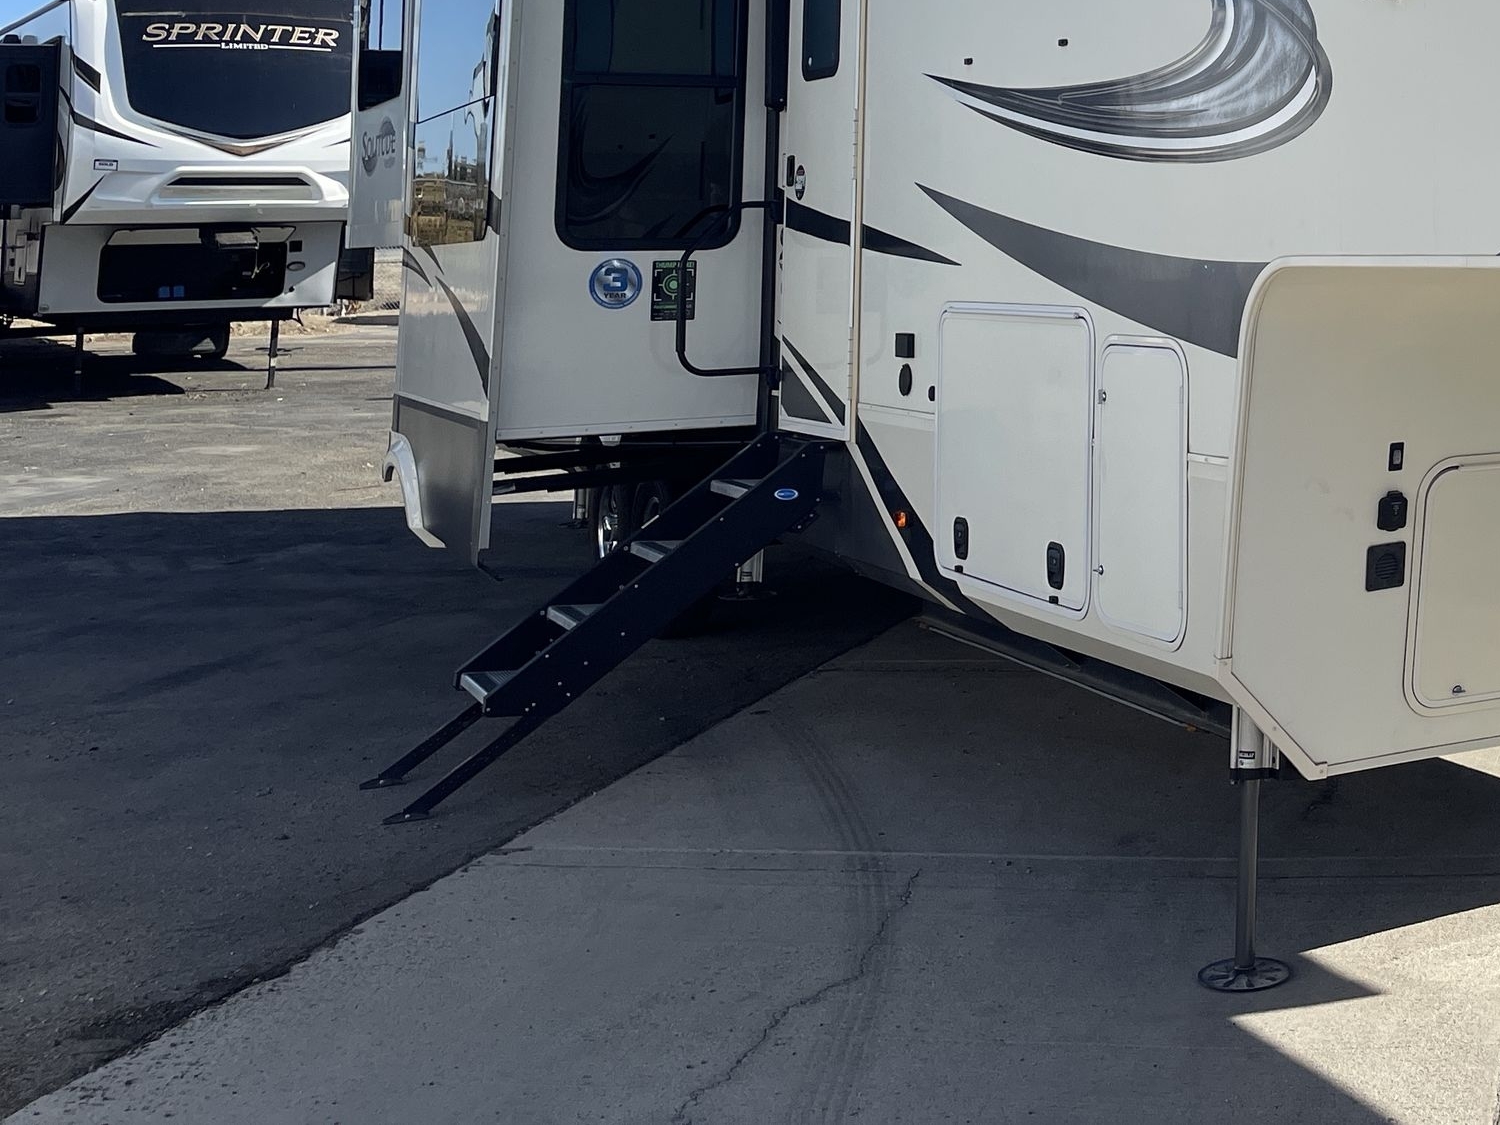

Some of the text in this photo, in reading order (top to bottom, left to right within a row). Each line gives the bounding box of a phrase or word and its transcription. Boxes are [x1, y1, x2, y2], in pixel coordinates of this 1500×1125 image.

[142, 23, 340, 47] SPRINTER
[220, 42, 269, 50] LIMITED
[603, 267, 629, 292] 3
